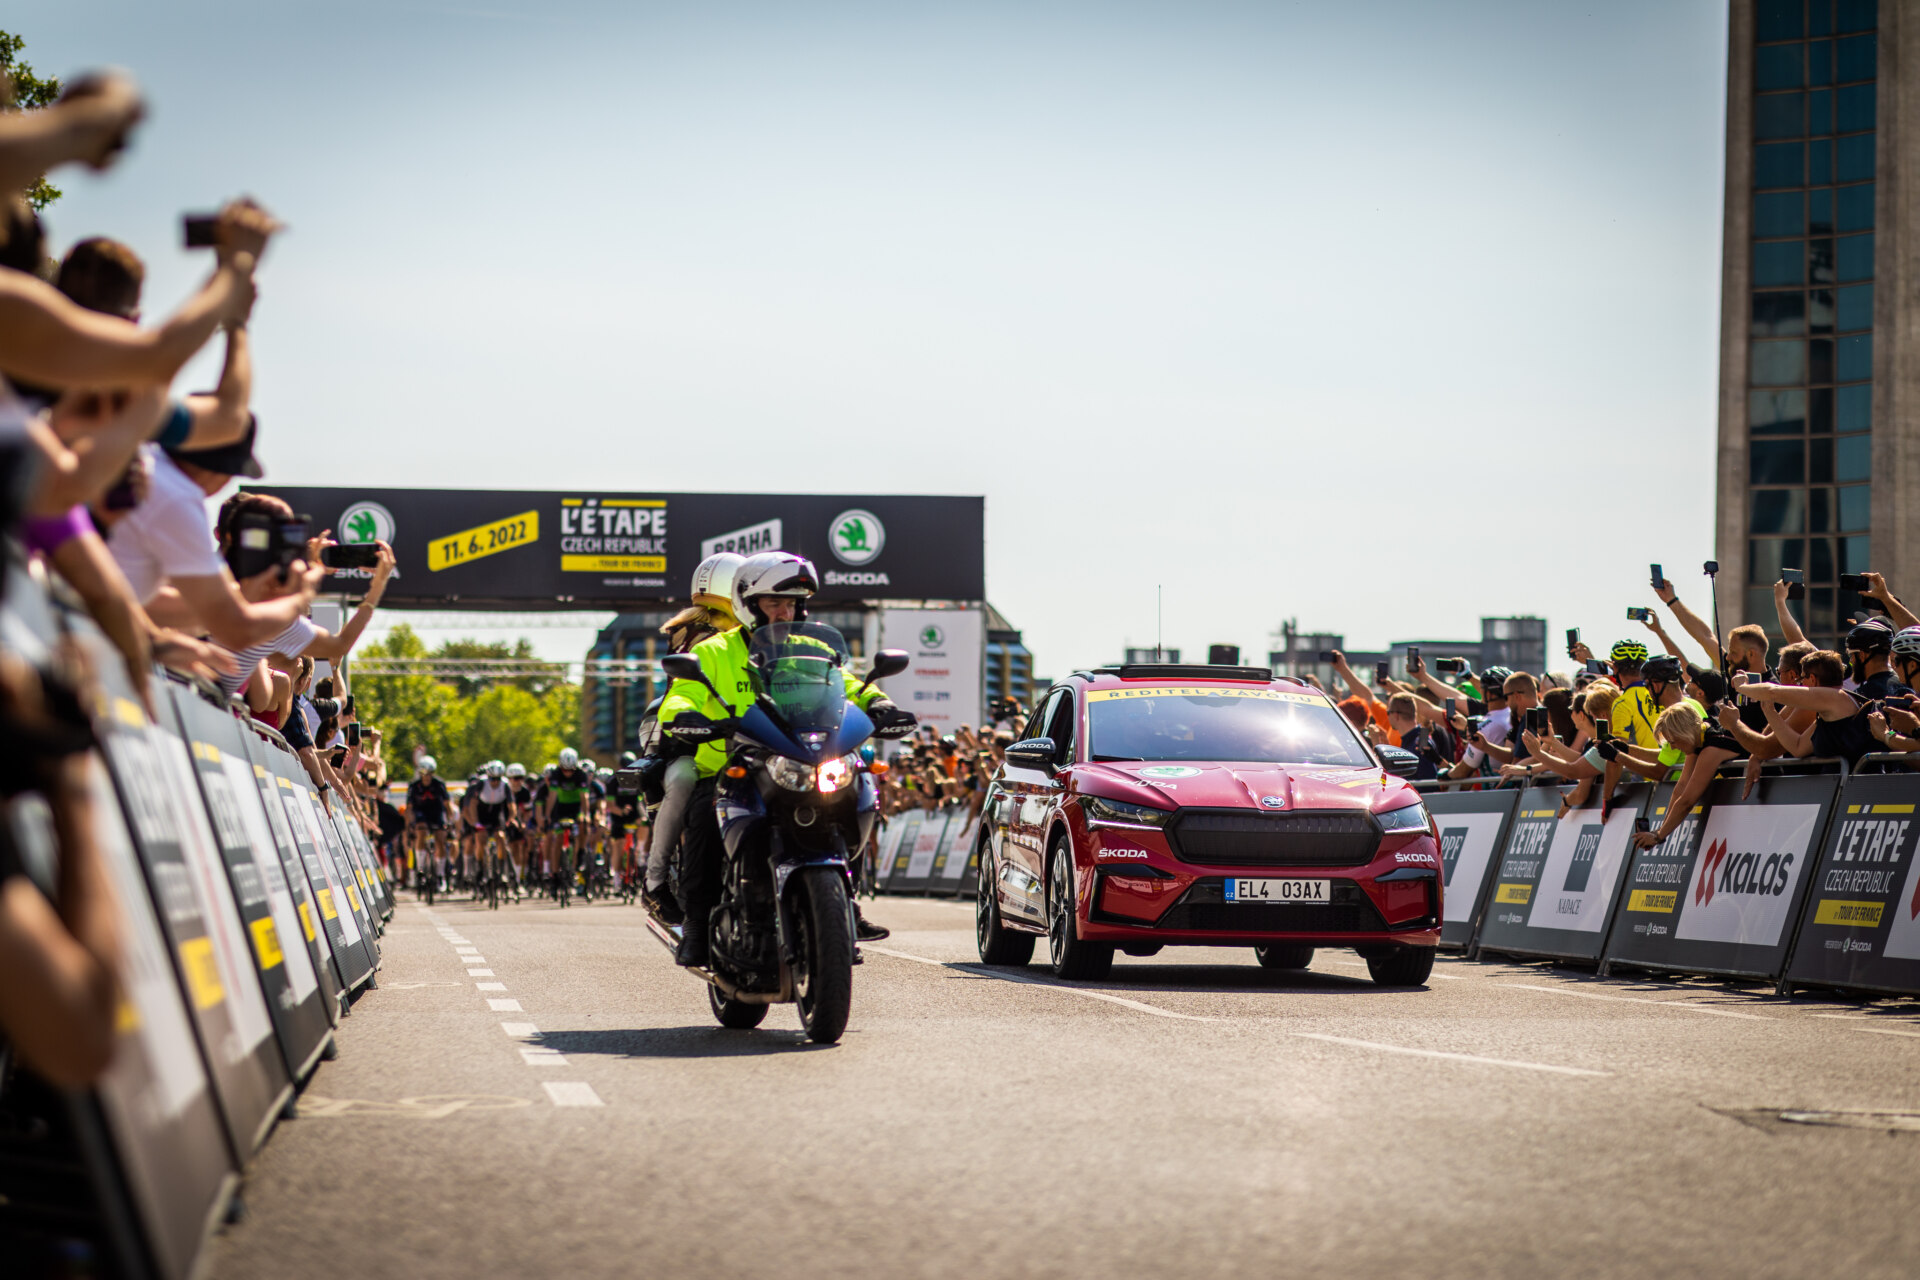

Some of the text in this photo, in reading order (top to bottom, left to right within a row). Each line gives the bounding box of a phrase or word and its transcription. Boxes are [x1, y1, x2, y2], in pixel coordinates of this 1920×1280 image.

[443, 520, 526, 562] 11. 6. 2022
[561, 537, 667, 553] CZECH REPUBLIC
[824, 570, 890, 585] ŠKODA
[1109, 688, 1205, 698] ŘEDITEL
[1098, 848, 1148, 858] ŠKODA
[1441, 835, 1463, 860] PPF
[1574, 834, 1600, 861] PPF
[1395, 853, 1435, 863] ŠKODA
[1653, 863, 1685, 883] REPUBLIC
[1824, 869, 1895, 894] CZECH REPUBLIC
[1239, 881, 1322, 899] EL4 03AX
[1556, 899, 1583, 915] NADACE
[1838, 905, 1854, 920] TOUR
[1860, 906, 1881, 922] FRANCE
[1850, 939, 1872, 952] ŠKODA
